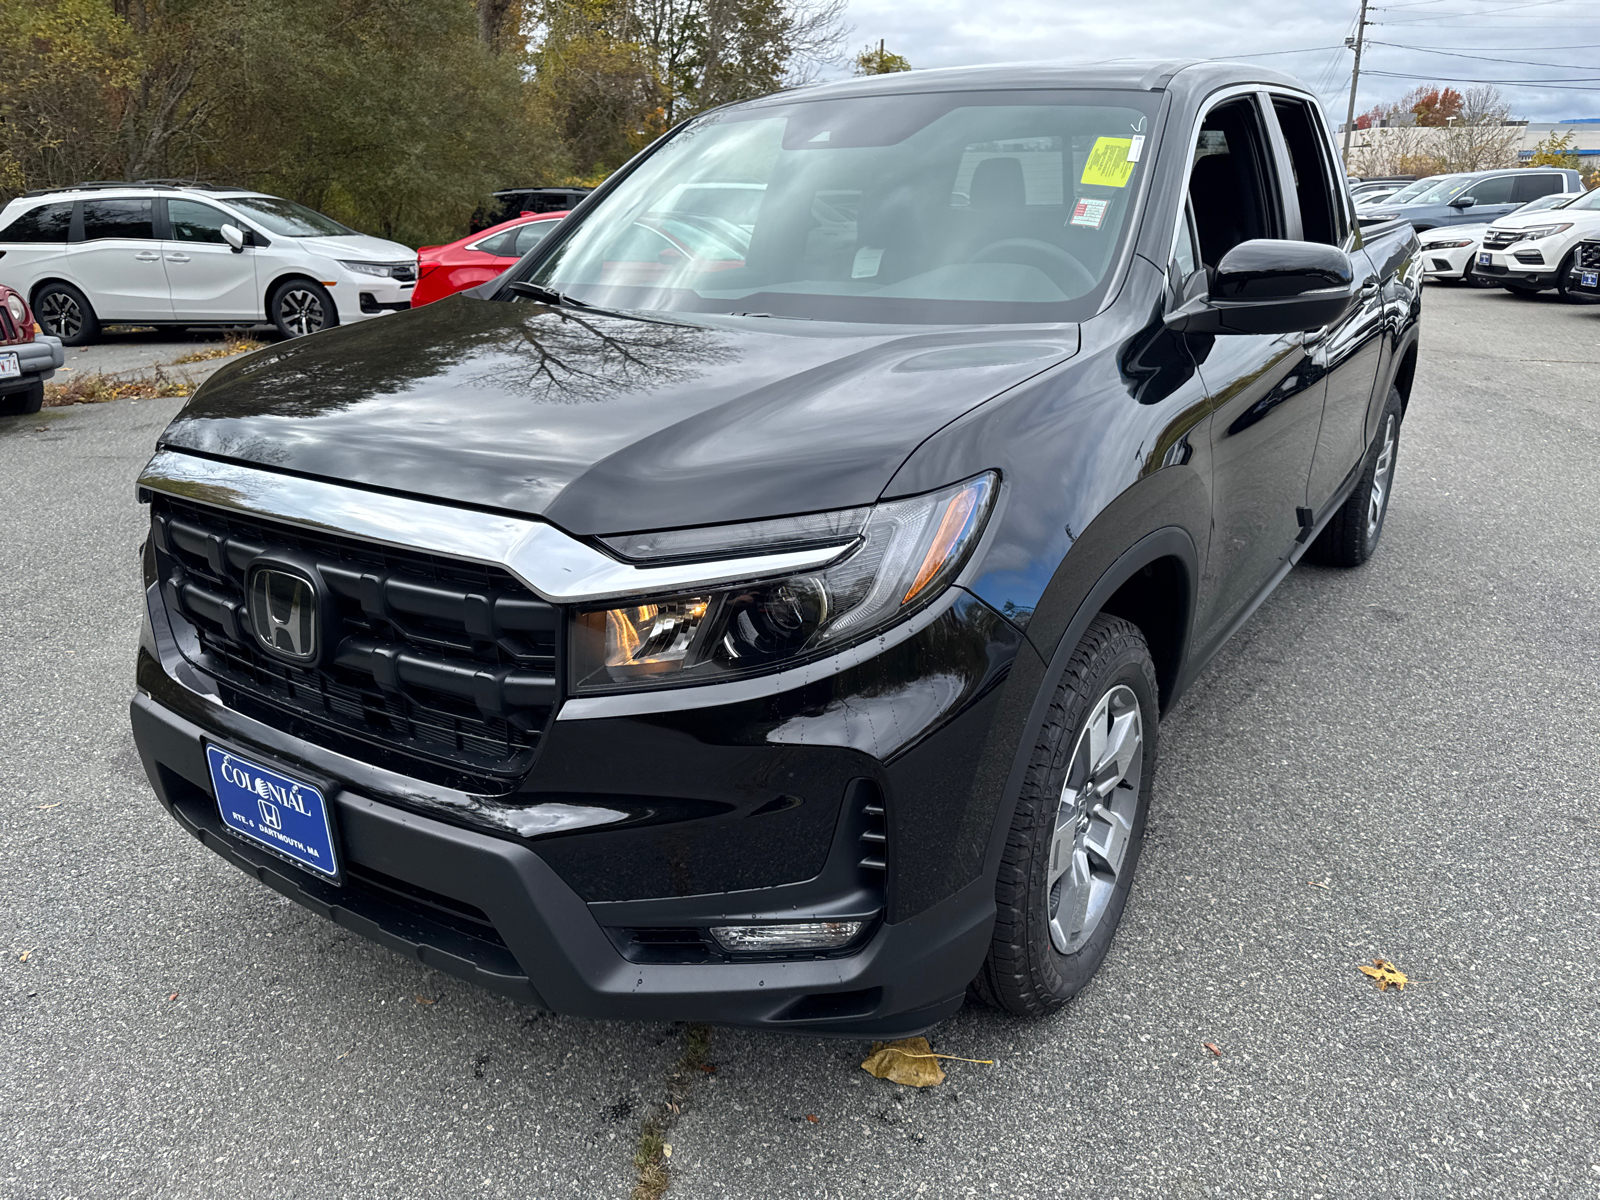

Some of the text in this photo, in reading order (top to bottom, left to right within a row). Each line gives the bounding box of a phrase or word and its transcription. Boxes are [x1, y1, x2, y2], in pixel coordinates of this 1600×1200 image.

[221, 763, 312, 817] COLONIAL
[232, 811, 320, 858] RTE. 6 DARTMOUTH, MA
